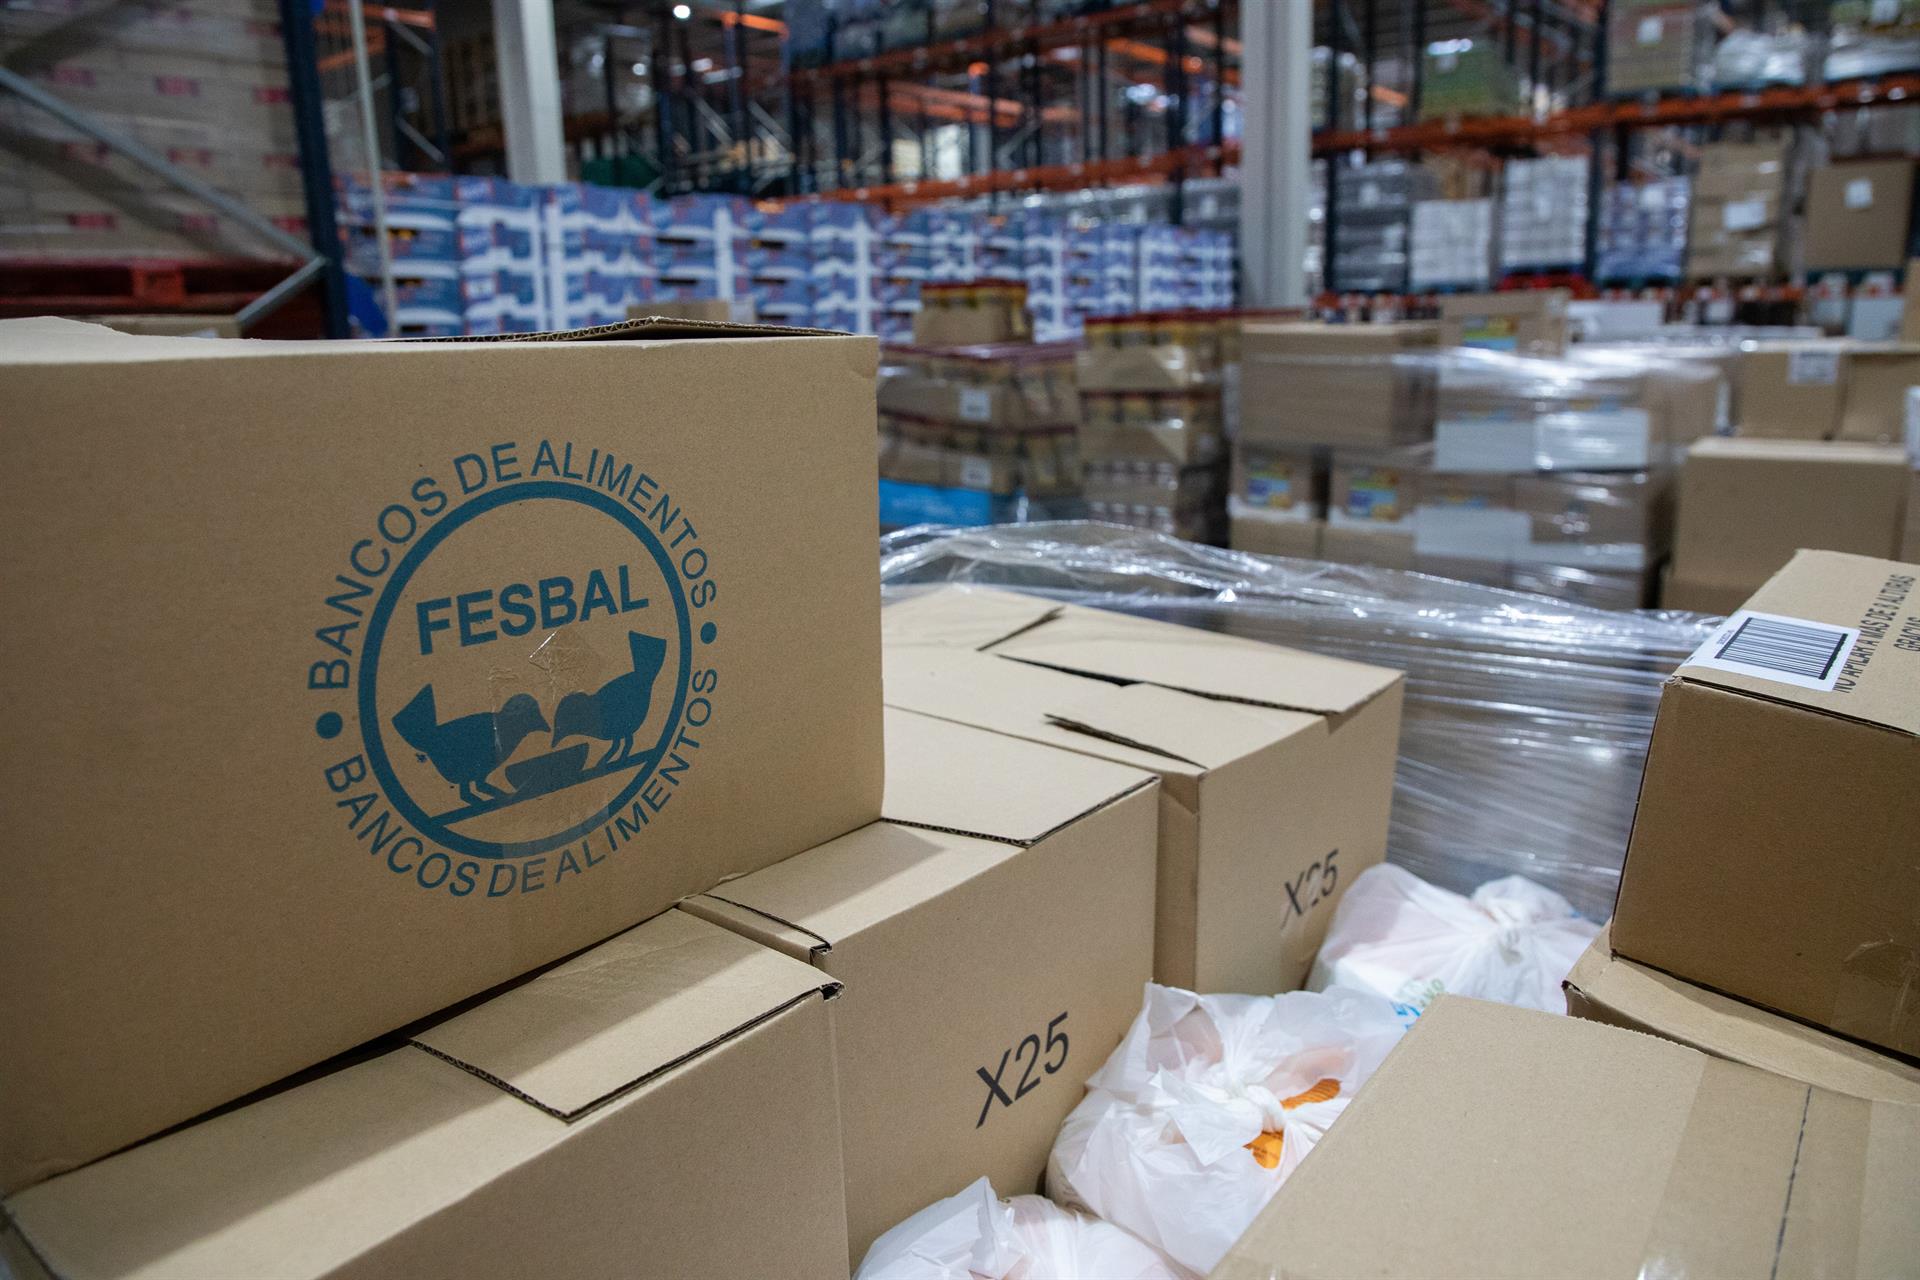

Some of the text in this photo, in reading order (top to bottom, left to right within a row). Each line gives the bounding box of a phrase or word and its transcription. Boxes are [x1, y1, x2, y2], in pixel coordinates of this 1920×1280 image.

[309, 439, 717, 690] BANCOS DE ALIMENTOS
[415, 564, 650, 656] FESBAL
[1859, 619, 1890, 639] MAS
[1865, 607, 1897, 621] DE
[324, 667, 717, 898] BANCOS DE ALIMENTOS
[1280, 848, 1340, 930] X25
[974, 1011, 1070, 1130] X25
